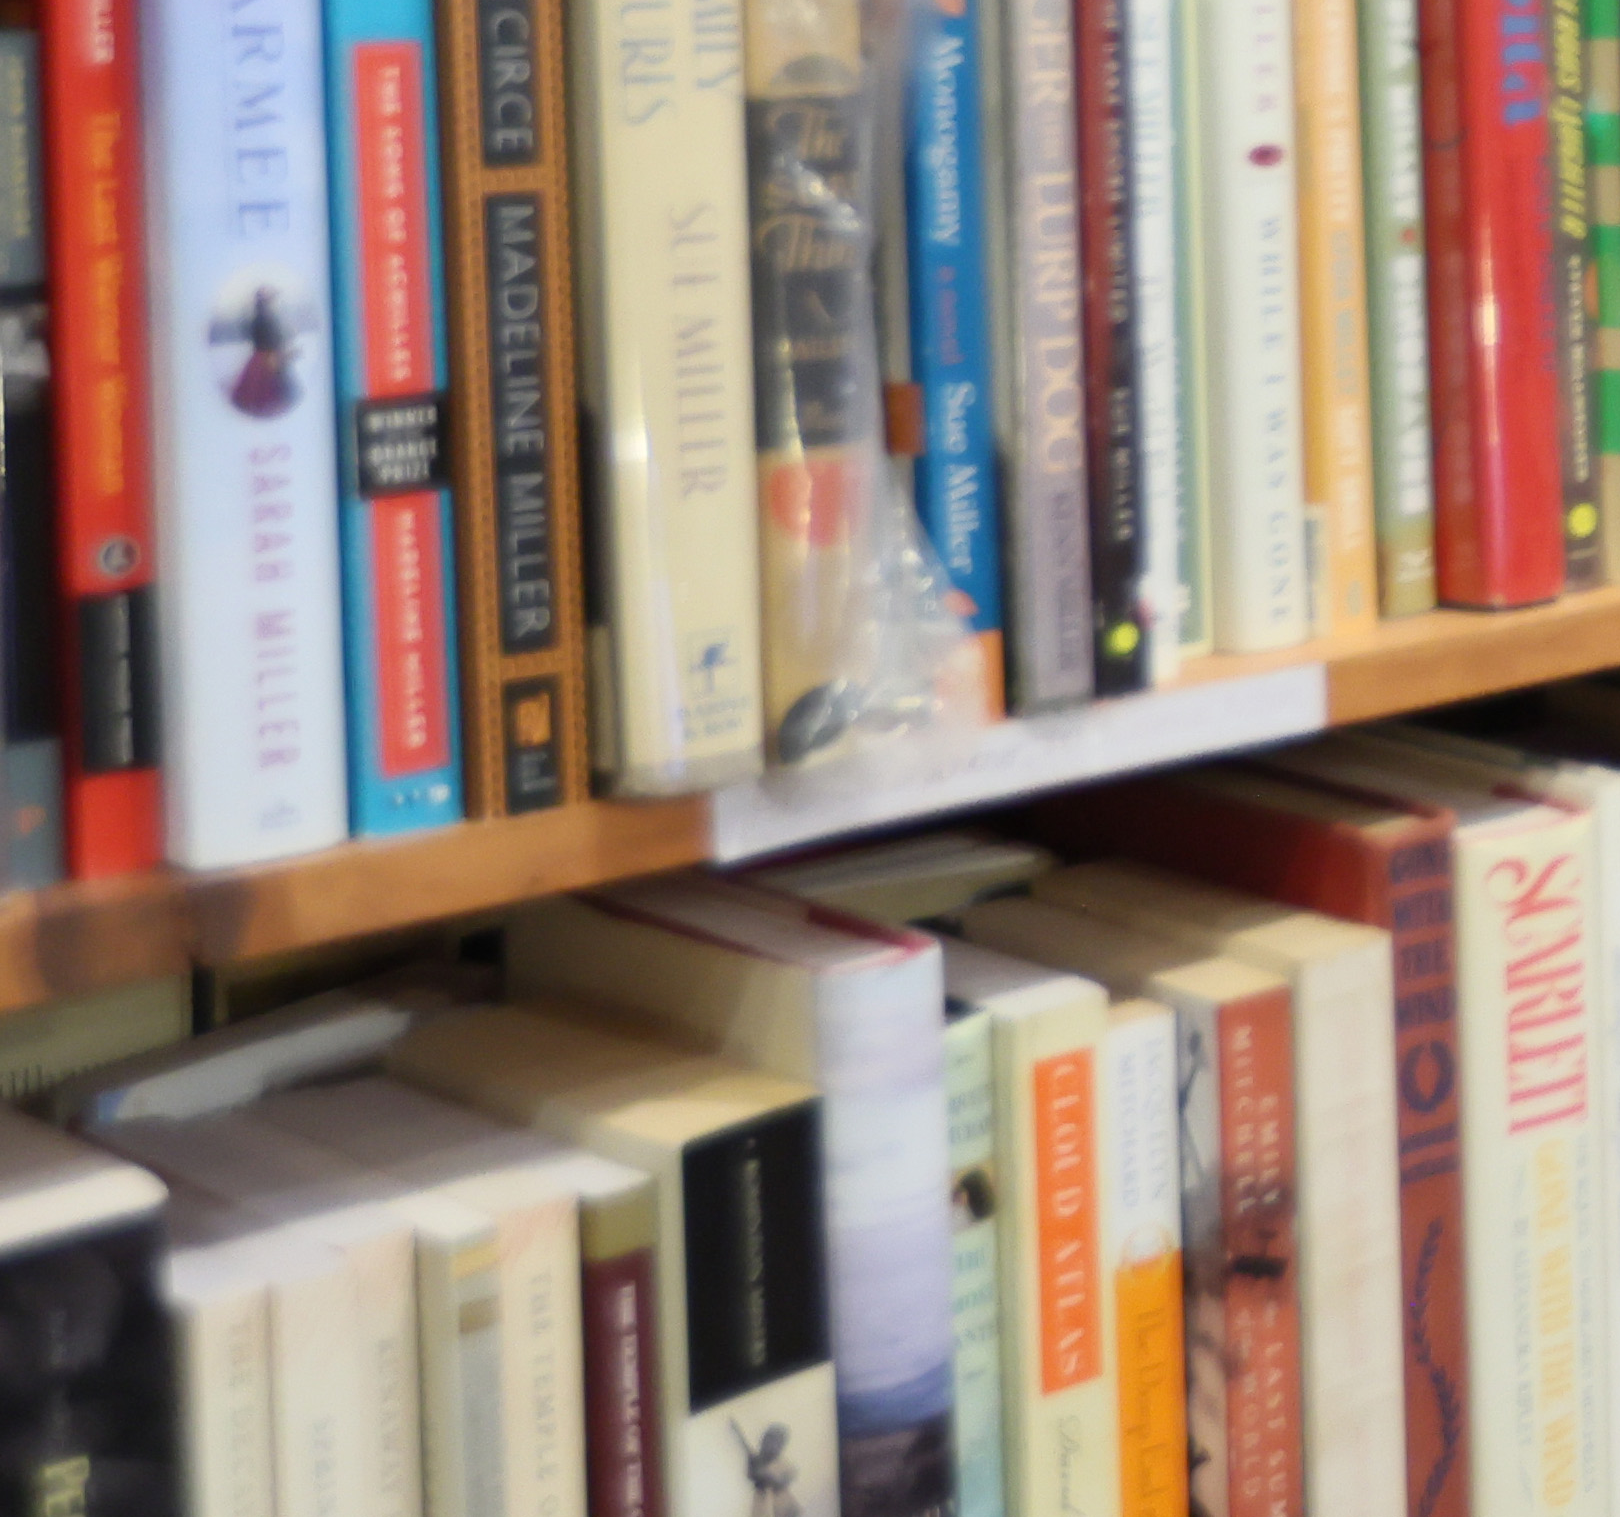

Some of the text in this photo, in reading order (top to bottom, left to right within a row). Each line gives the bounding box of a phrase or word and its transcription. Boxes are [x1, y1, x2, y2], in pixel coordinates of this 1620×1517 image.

[919, 35, 966, 246] Monogamy
[381, 125, 413, 383] SONG OF ACHILLES
[490, 6, 552, 639] CIRCE MADELINE MILLER
[1030, 171, 1083, 473] LURP DOG
[671, 306, 731, 502] MILLER
[940, 382, 982, 575] Sue Miller
[247, 440, 302, 770] SARAH MILLER
[1265, 509, 1292, 628] GONE
[403, 652, 430, 749] MILLER
[1484, 853, 1592, 1139] SCARLETT
[1046, 1059, 1086, 1378] CLOUD ATLAS
[1233, 1023, 1258, 1216] MITCHELL
[1259, 1093, 1281, 1206] EMILY
[1239, 1388, 1262, 1498] WORLD
